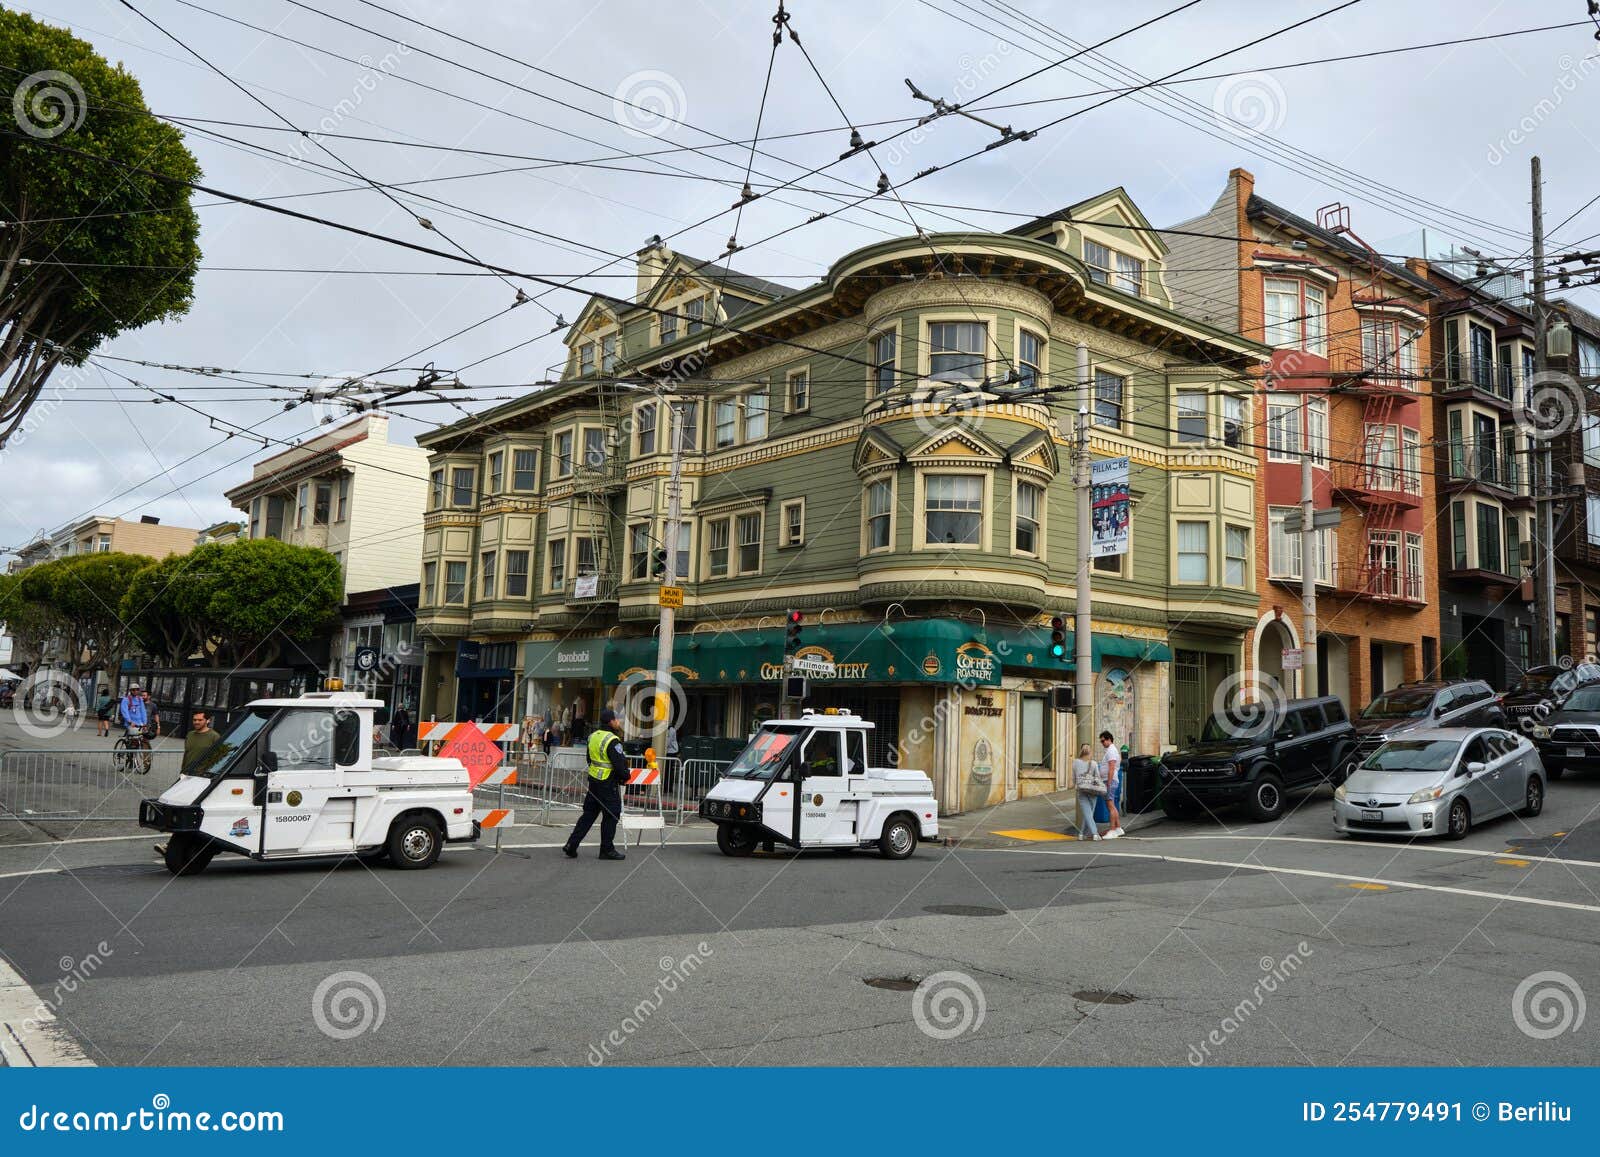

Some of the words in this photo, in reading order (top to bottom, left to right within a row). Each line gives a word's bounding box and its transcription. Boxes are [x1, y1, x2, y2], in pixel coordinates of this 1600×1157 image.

[1092, 460, 1128, 473] FILLMORE
[664, 589, 680, 597] MUNI
[661, 597, 682, 605] SIGNAL
[798, 660, 830, 671] Fillmore
[956, 653, 993, 670] COFFEE
[956, 668, 992, 681] ROASTERY
[964, 706, 1004, 717] ROASTERY
[452, 742, 487, 753] ROAD
[275, 814, 311, 823] 15800067
